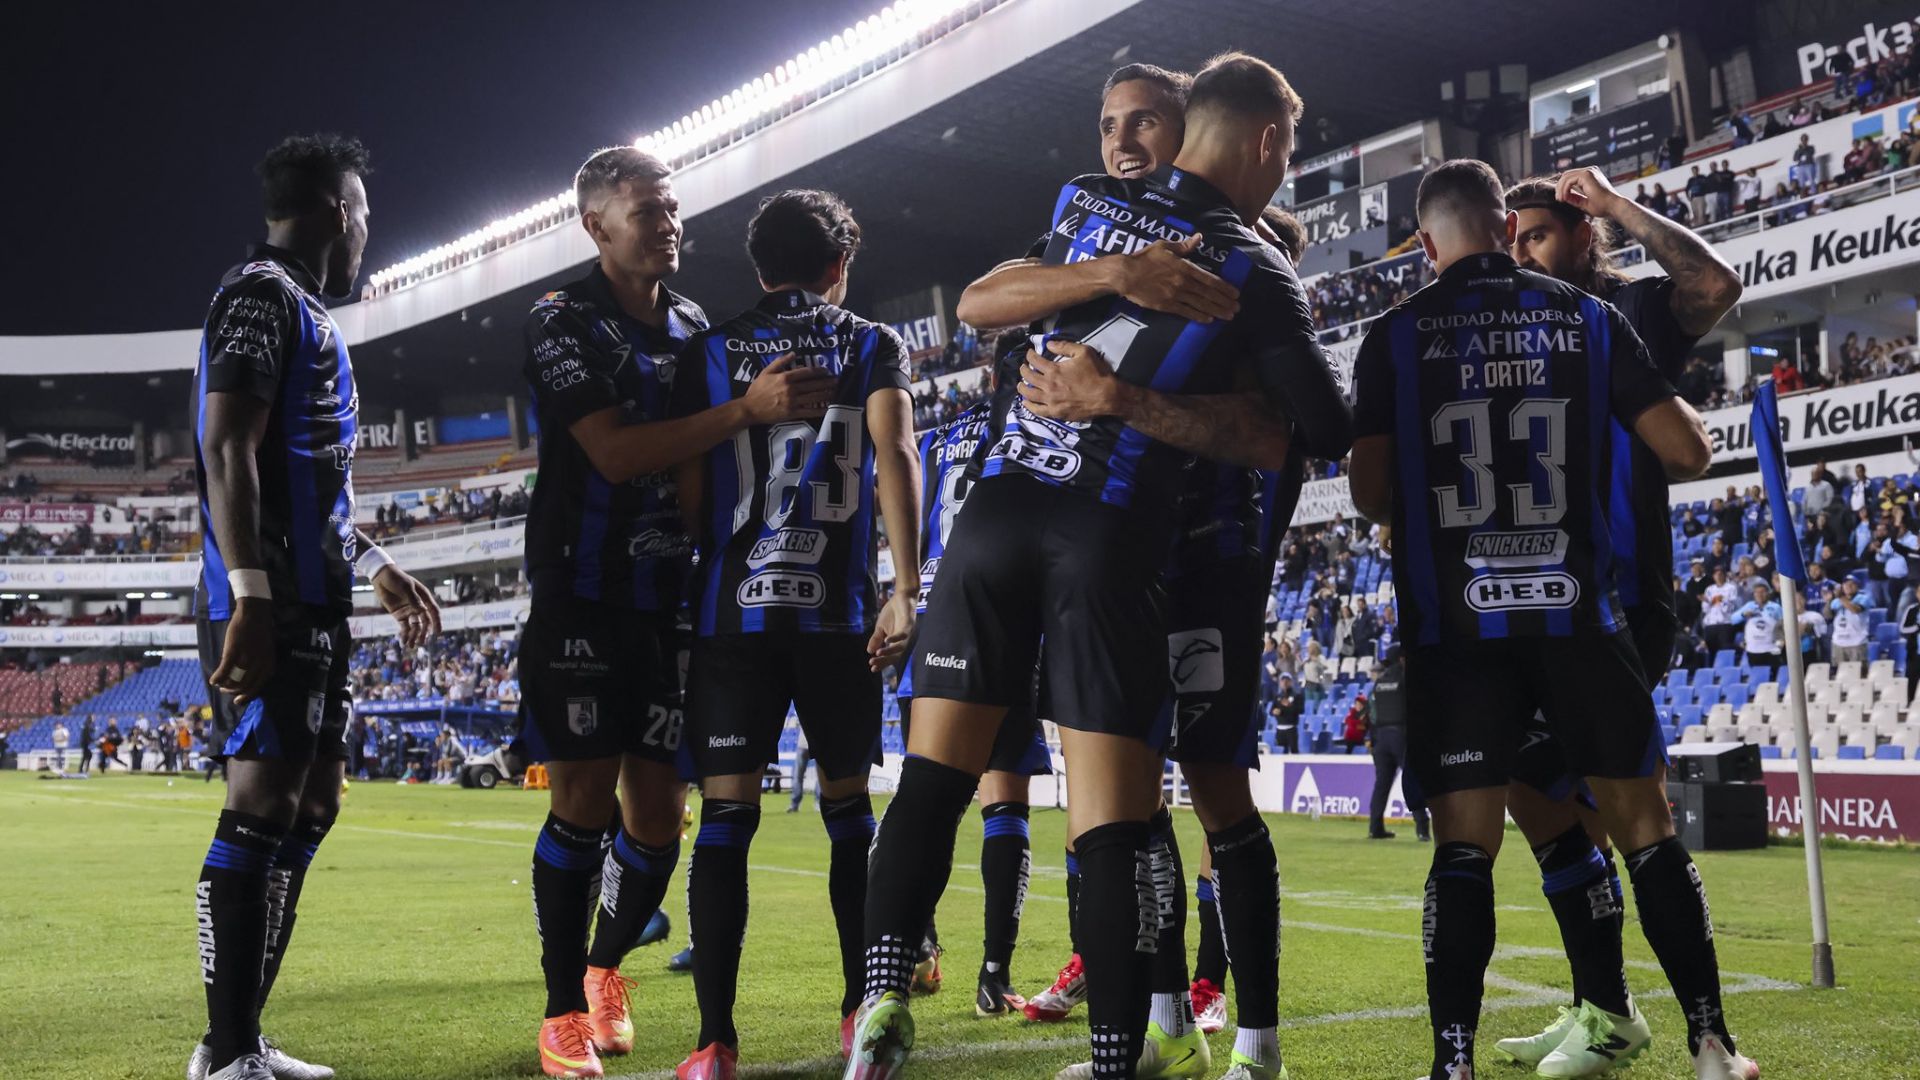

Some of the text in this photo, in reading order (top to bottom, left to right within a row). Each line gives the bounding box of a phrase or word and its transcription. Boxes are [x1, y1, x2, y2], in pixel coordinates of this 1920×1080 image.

[1072, 189, 1133, 223] CIUDAD
[1416, 309, 1583, 332] CIUDAD MADERAS
[225, 341, 268, 361] CLICK
[725, 336, 792, 355] CIUDAD
[1465, 330, 1582, 356] AFIRME
[552, 368, 592, 391] CLICK
[1461, 359, 1546, 390] P. ORTIZ
[1803, 388, 1920, 440] Keuka
[1430, 398, 1571, 528] 33
[1470, 533, 1555, 557] SNICKERS
[747, 580, 815, 598] H-E-B
[1479, 581, 1566, 602] H-E-B
[925, 652, 967, 670] Keuka
[643, 704, 684, 751] 28
[709, 734, 747, 748] Keuka
[1440, 750, 1483, 767] Keuka
[1324, 796, 1360, 814] PETRO
